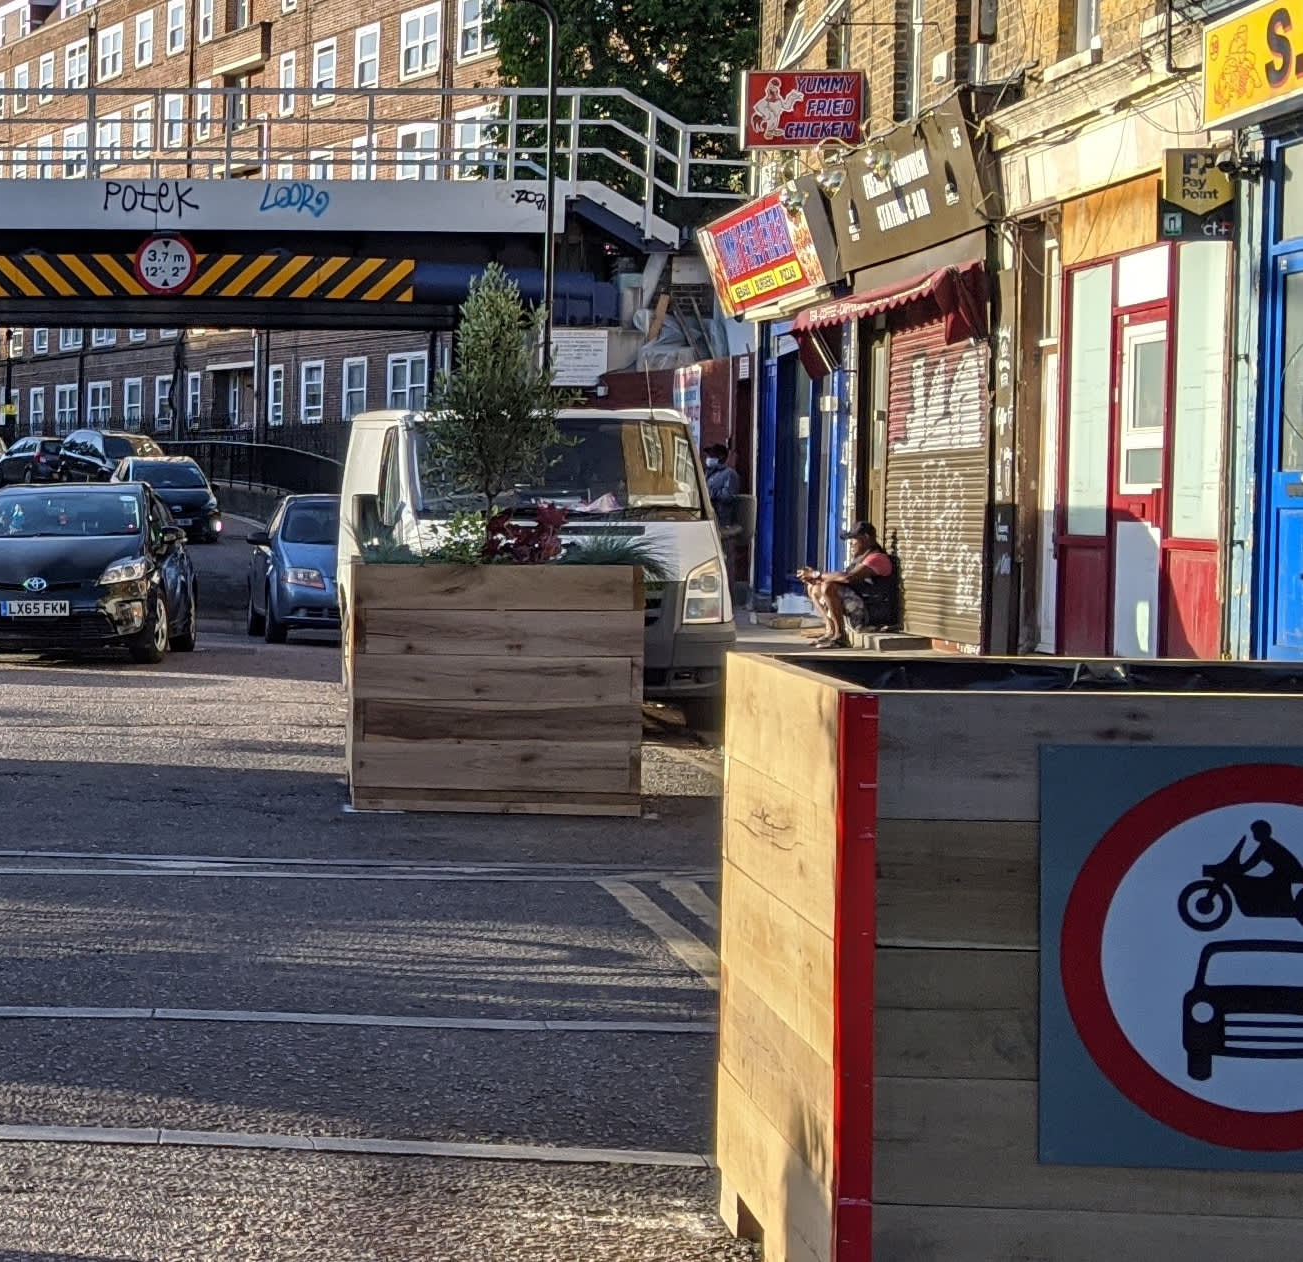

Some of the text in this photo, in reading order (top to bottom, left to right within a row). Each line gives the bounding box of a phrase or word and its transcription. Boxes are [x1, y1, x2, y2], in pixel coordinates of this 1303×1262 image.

[796, 75, 857, 94] YUMMY
[804, 99, 855, 117] FRIED
[784, 121, 855, 140] CHICKEN
[1182, 176, 1207, 190] Pay
[1182, 188, 1219, 200] Point
[8, 602, 67, 615] LX65 FKM
